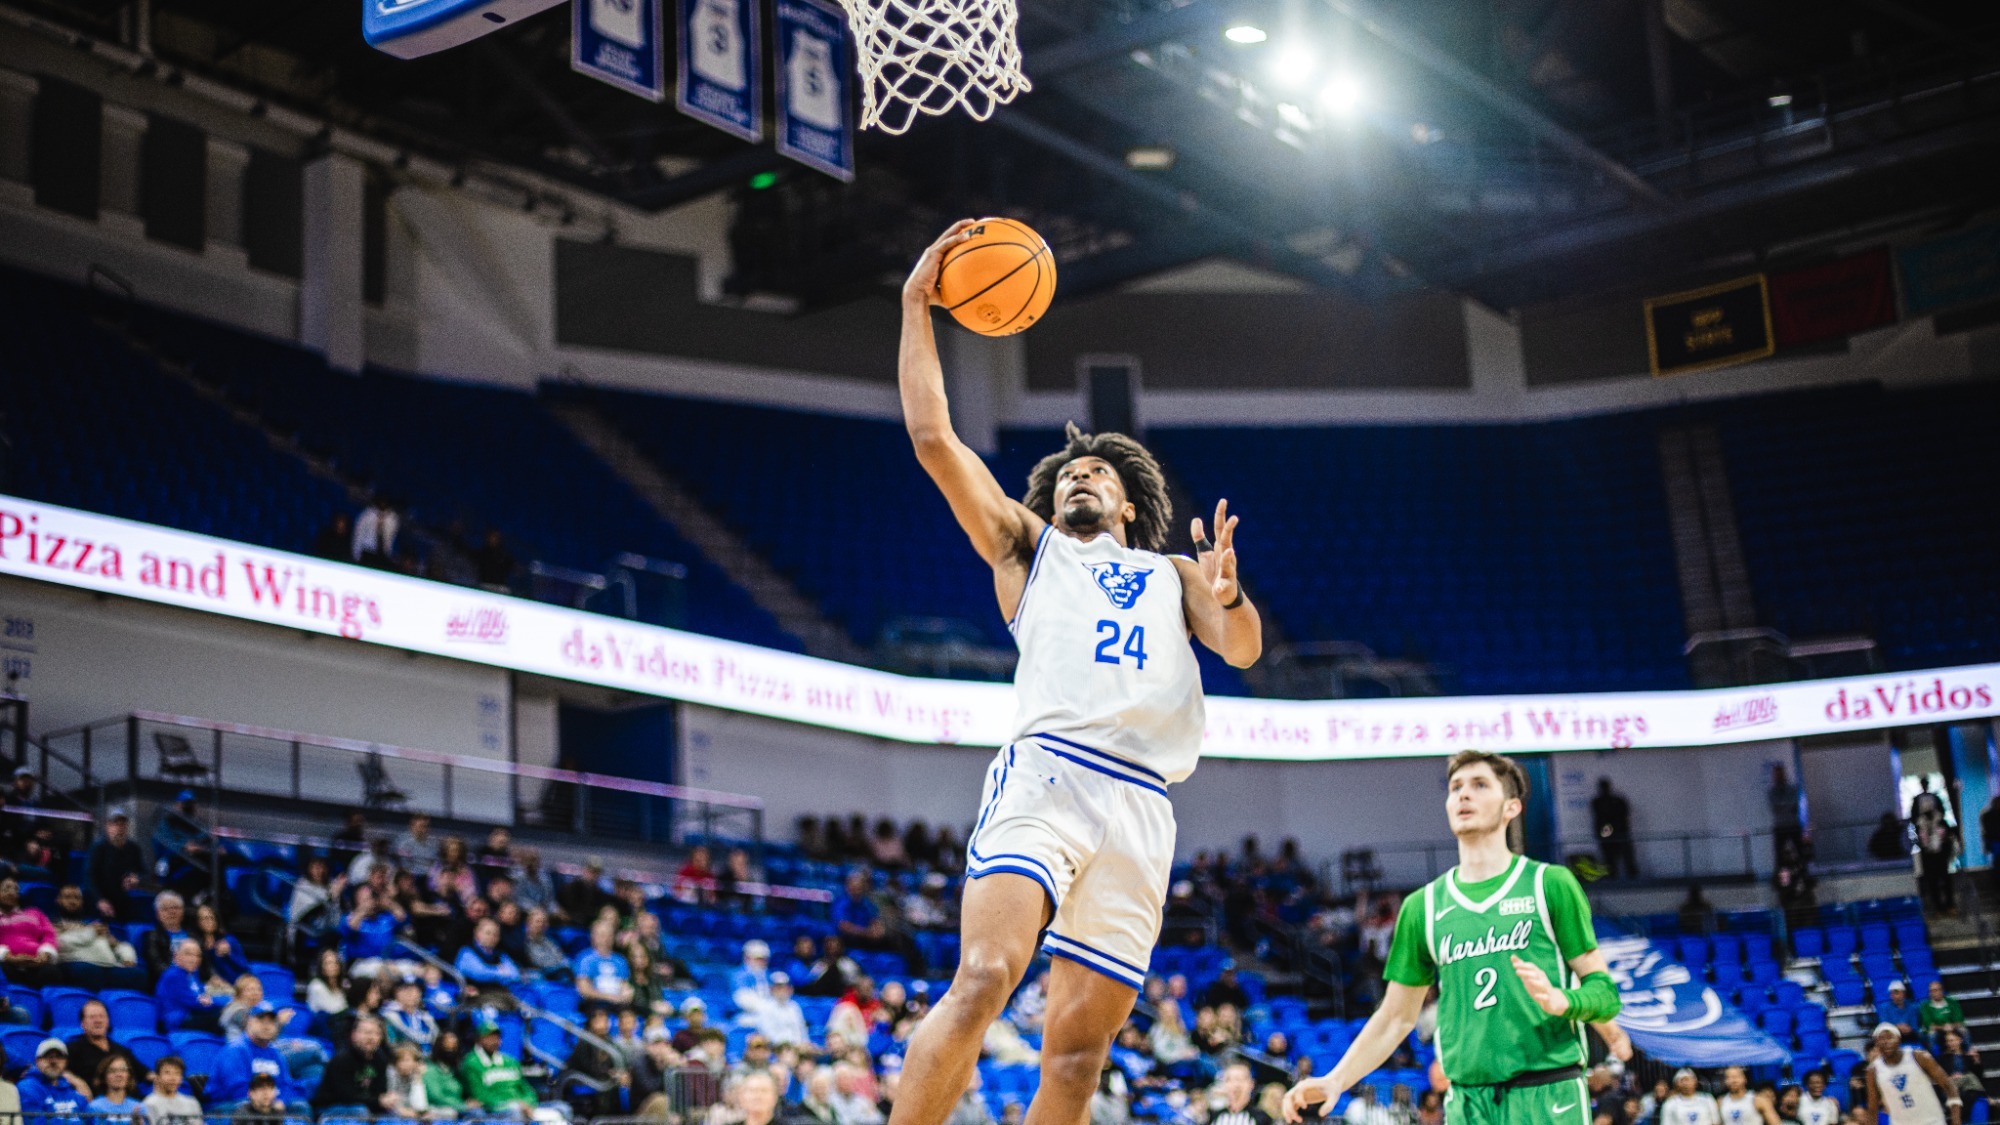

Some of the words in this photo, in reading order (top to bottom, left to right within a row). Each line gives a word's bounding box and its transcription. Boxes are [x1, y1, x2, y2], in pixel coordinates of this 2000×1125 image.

[0, 511, 124, 580] Pizza
[139, 551, 227, 599] and
[241, 559, 383, 640] Wings
[1095, 619, 1148, 670] 24
[1824, 678, 1993, 722] daVidos
[1445, 710, 1513, 740] and
[1525, 705, 1648, 750] Wings
[1439, 919, 1532, 966] Marshall
[1474, 967, 1498, 1010] 2
